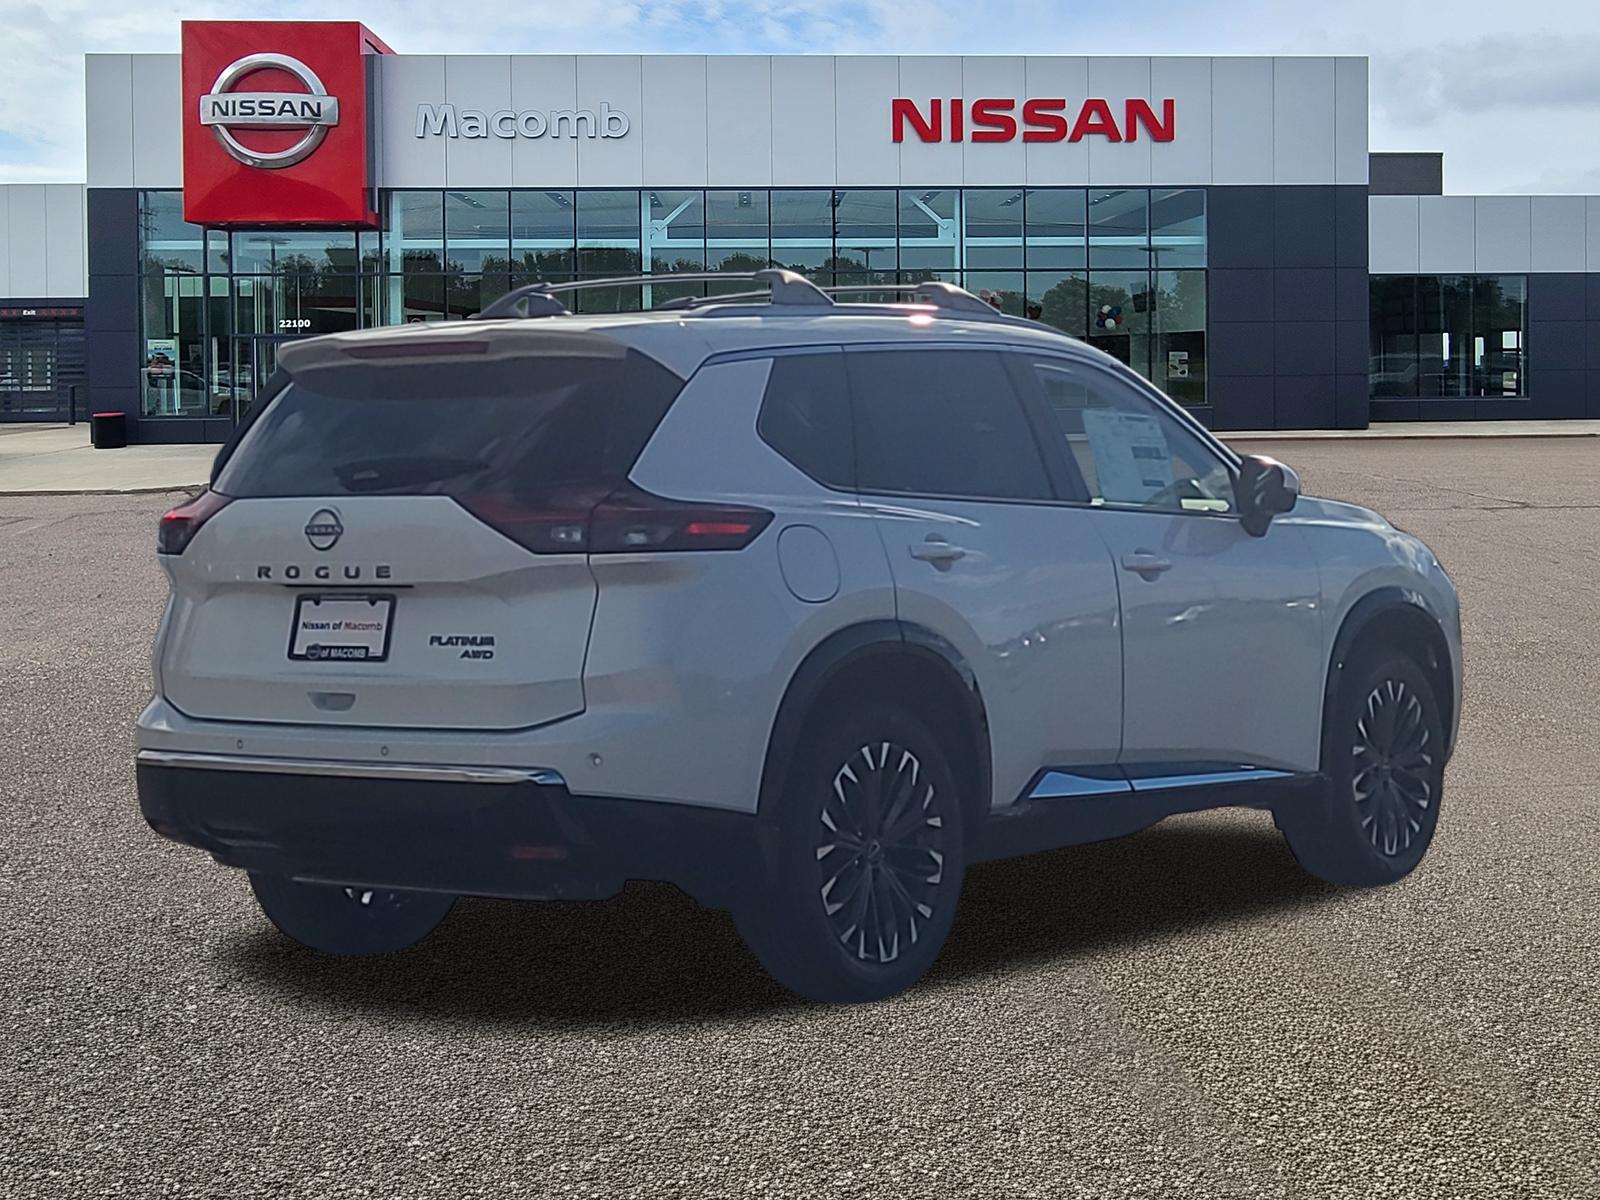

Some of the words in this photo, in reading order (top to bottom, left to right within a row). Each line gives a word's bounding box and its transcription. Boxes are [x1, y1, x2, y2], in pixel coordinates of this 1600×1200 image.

[211, 100, 322, 117] NISSAN
[415, 101, 630, 138] Macomb
[892, 98, 1175, 143] NISSAN
[279, 319, 311, 328] 22100
[257, 565, 392, 579] ROGUE
[302, 621, 331, 631] Nissan
[332, 621, 343, 631] of
[344, 622, 383, 631] Macomb
[429, 635, 495, 647] PLATINUM
[460, 649, 494, 660] AWD
